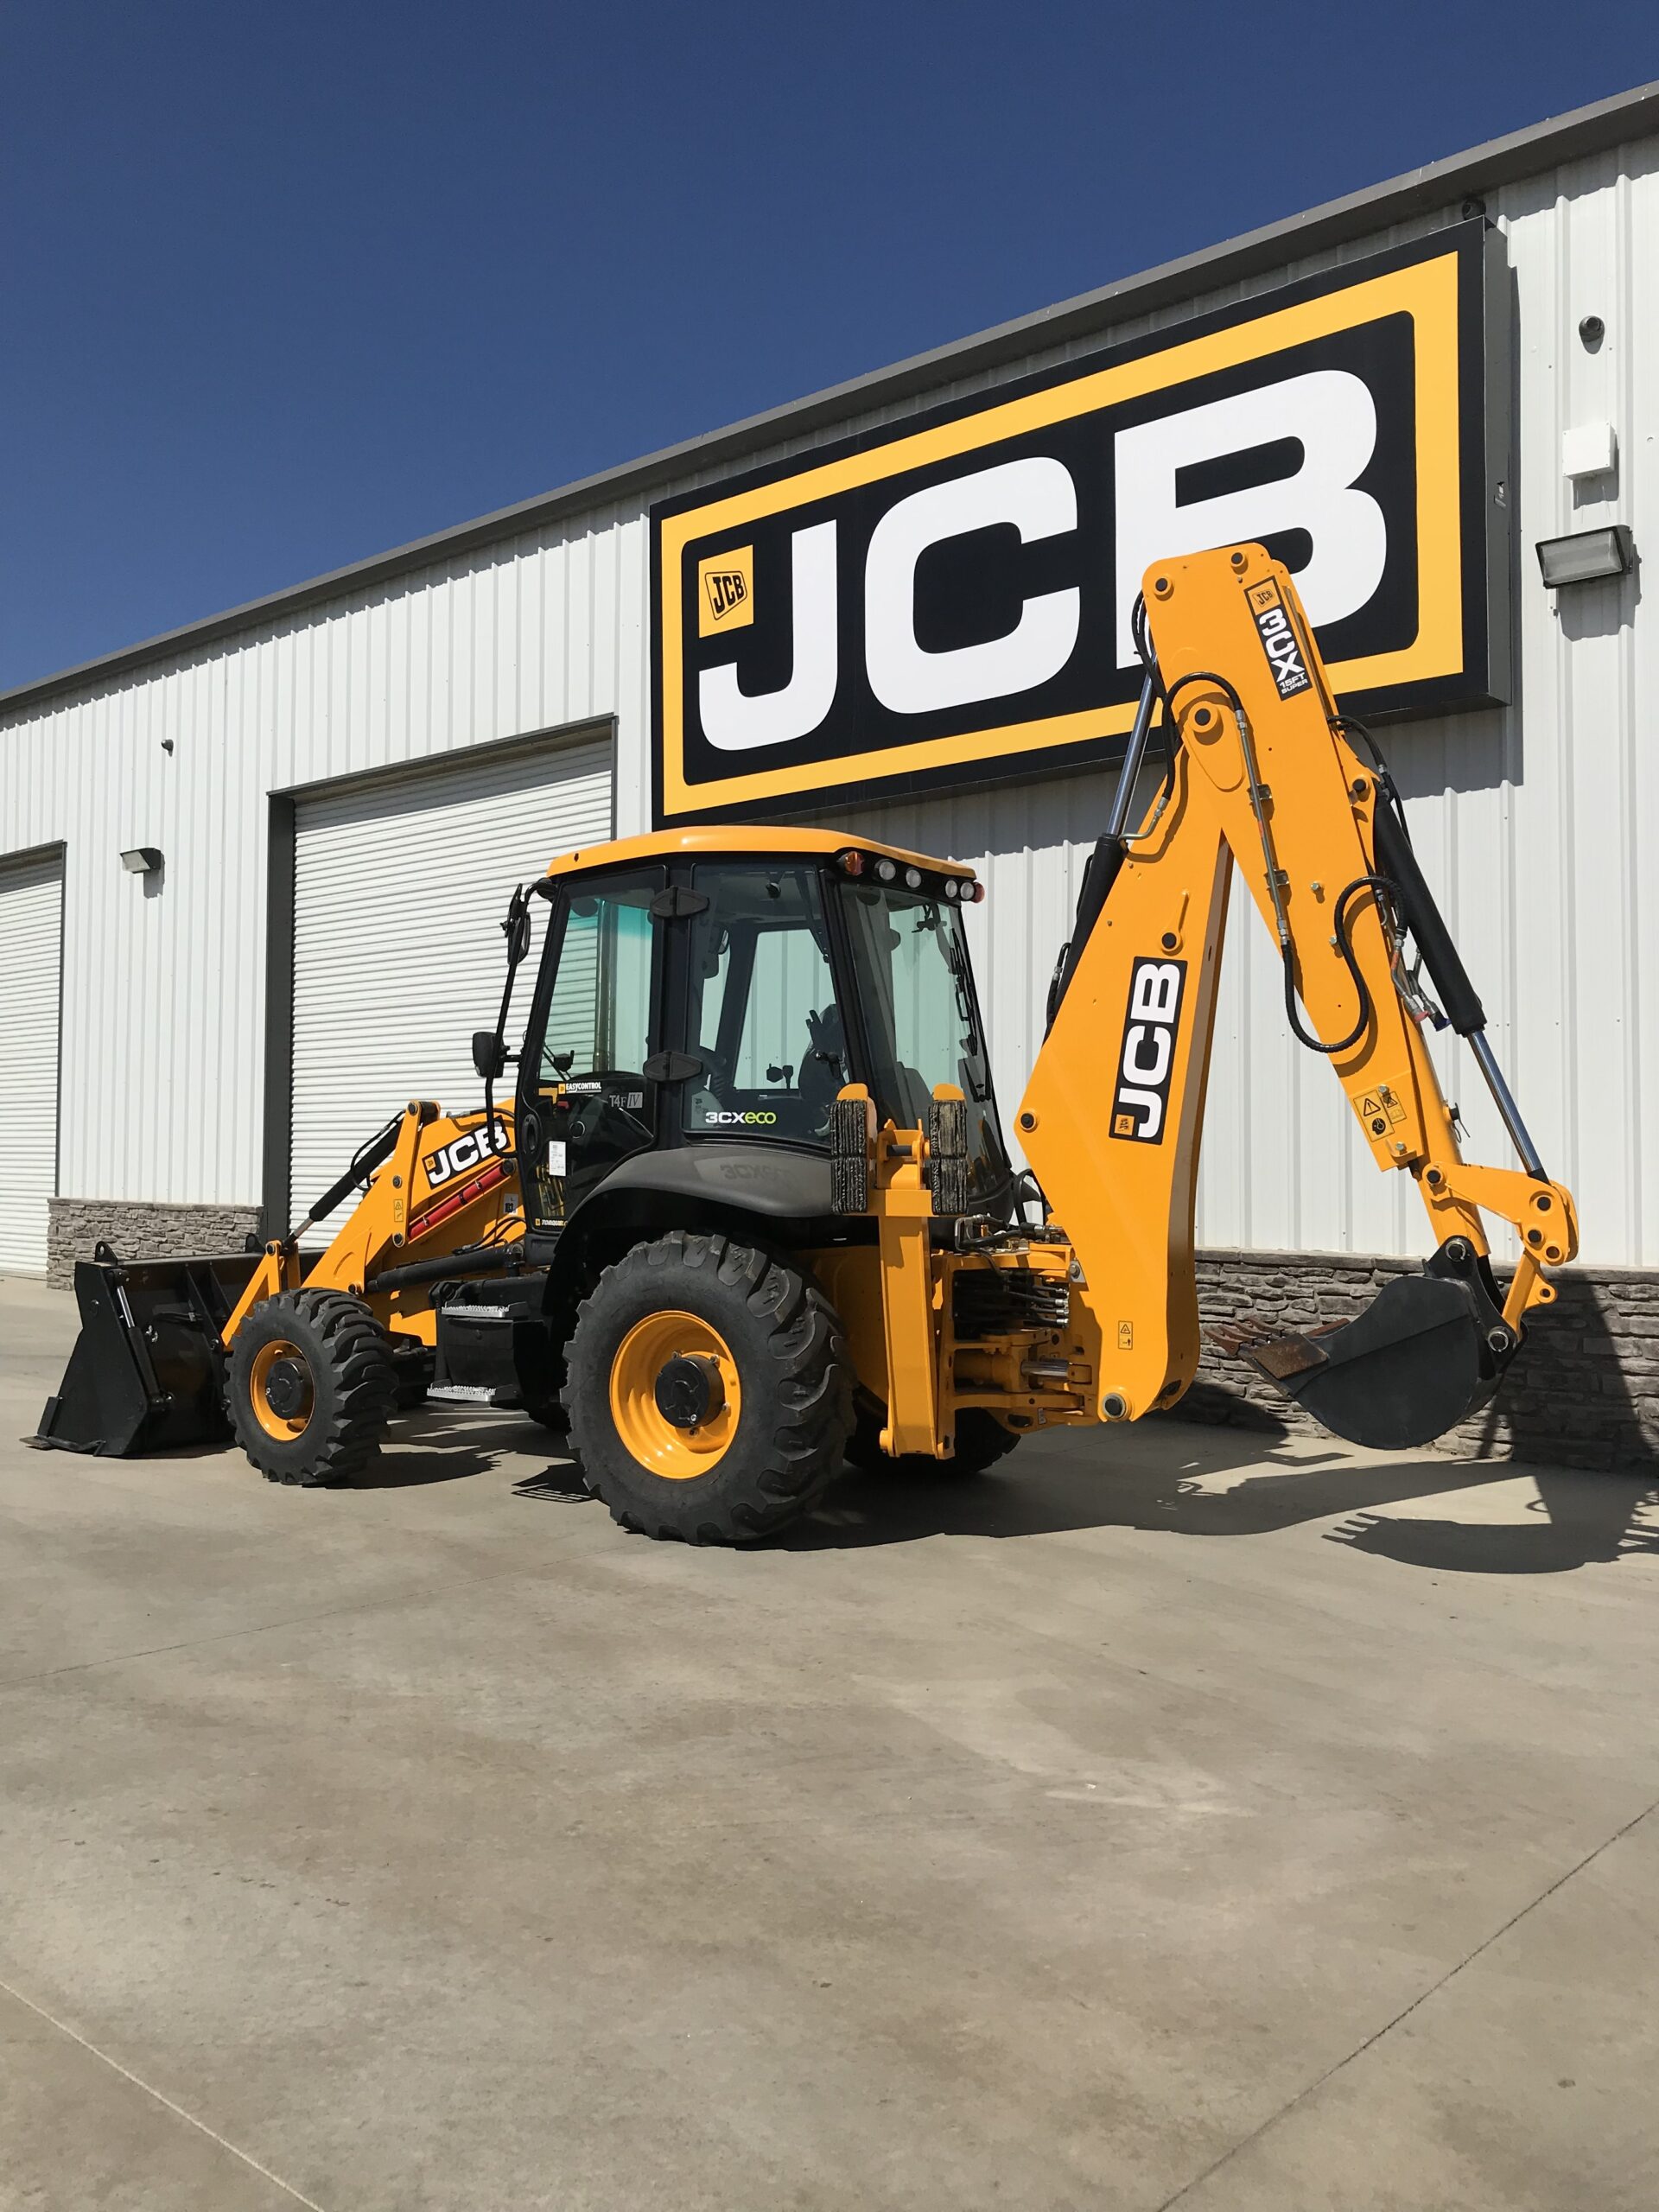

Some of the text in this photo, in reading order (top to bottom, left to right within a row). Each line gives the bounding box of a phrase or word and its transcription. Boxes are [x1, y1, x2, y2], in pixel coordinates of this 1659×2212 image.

[698, 370, 1387, 751] JCB
[712, 575, 744, 613] JCB
[1255, 589, 1274, 605] JCB
[1259, 608, 1306, 683] 3CX
[1280, 672, 1305, 689] 15FT
[1281, 678, 1308, 694] SUPER
[1118, 963, 1180, 1138] JCB
[566, 1082, 601, 1093] EASYCONTROL
[429, 1121, 507, 1185] JCB
